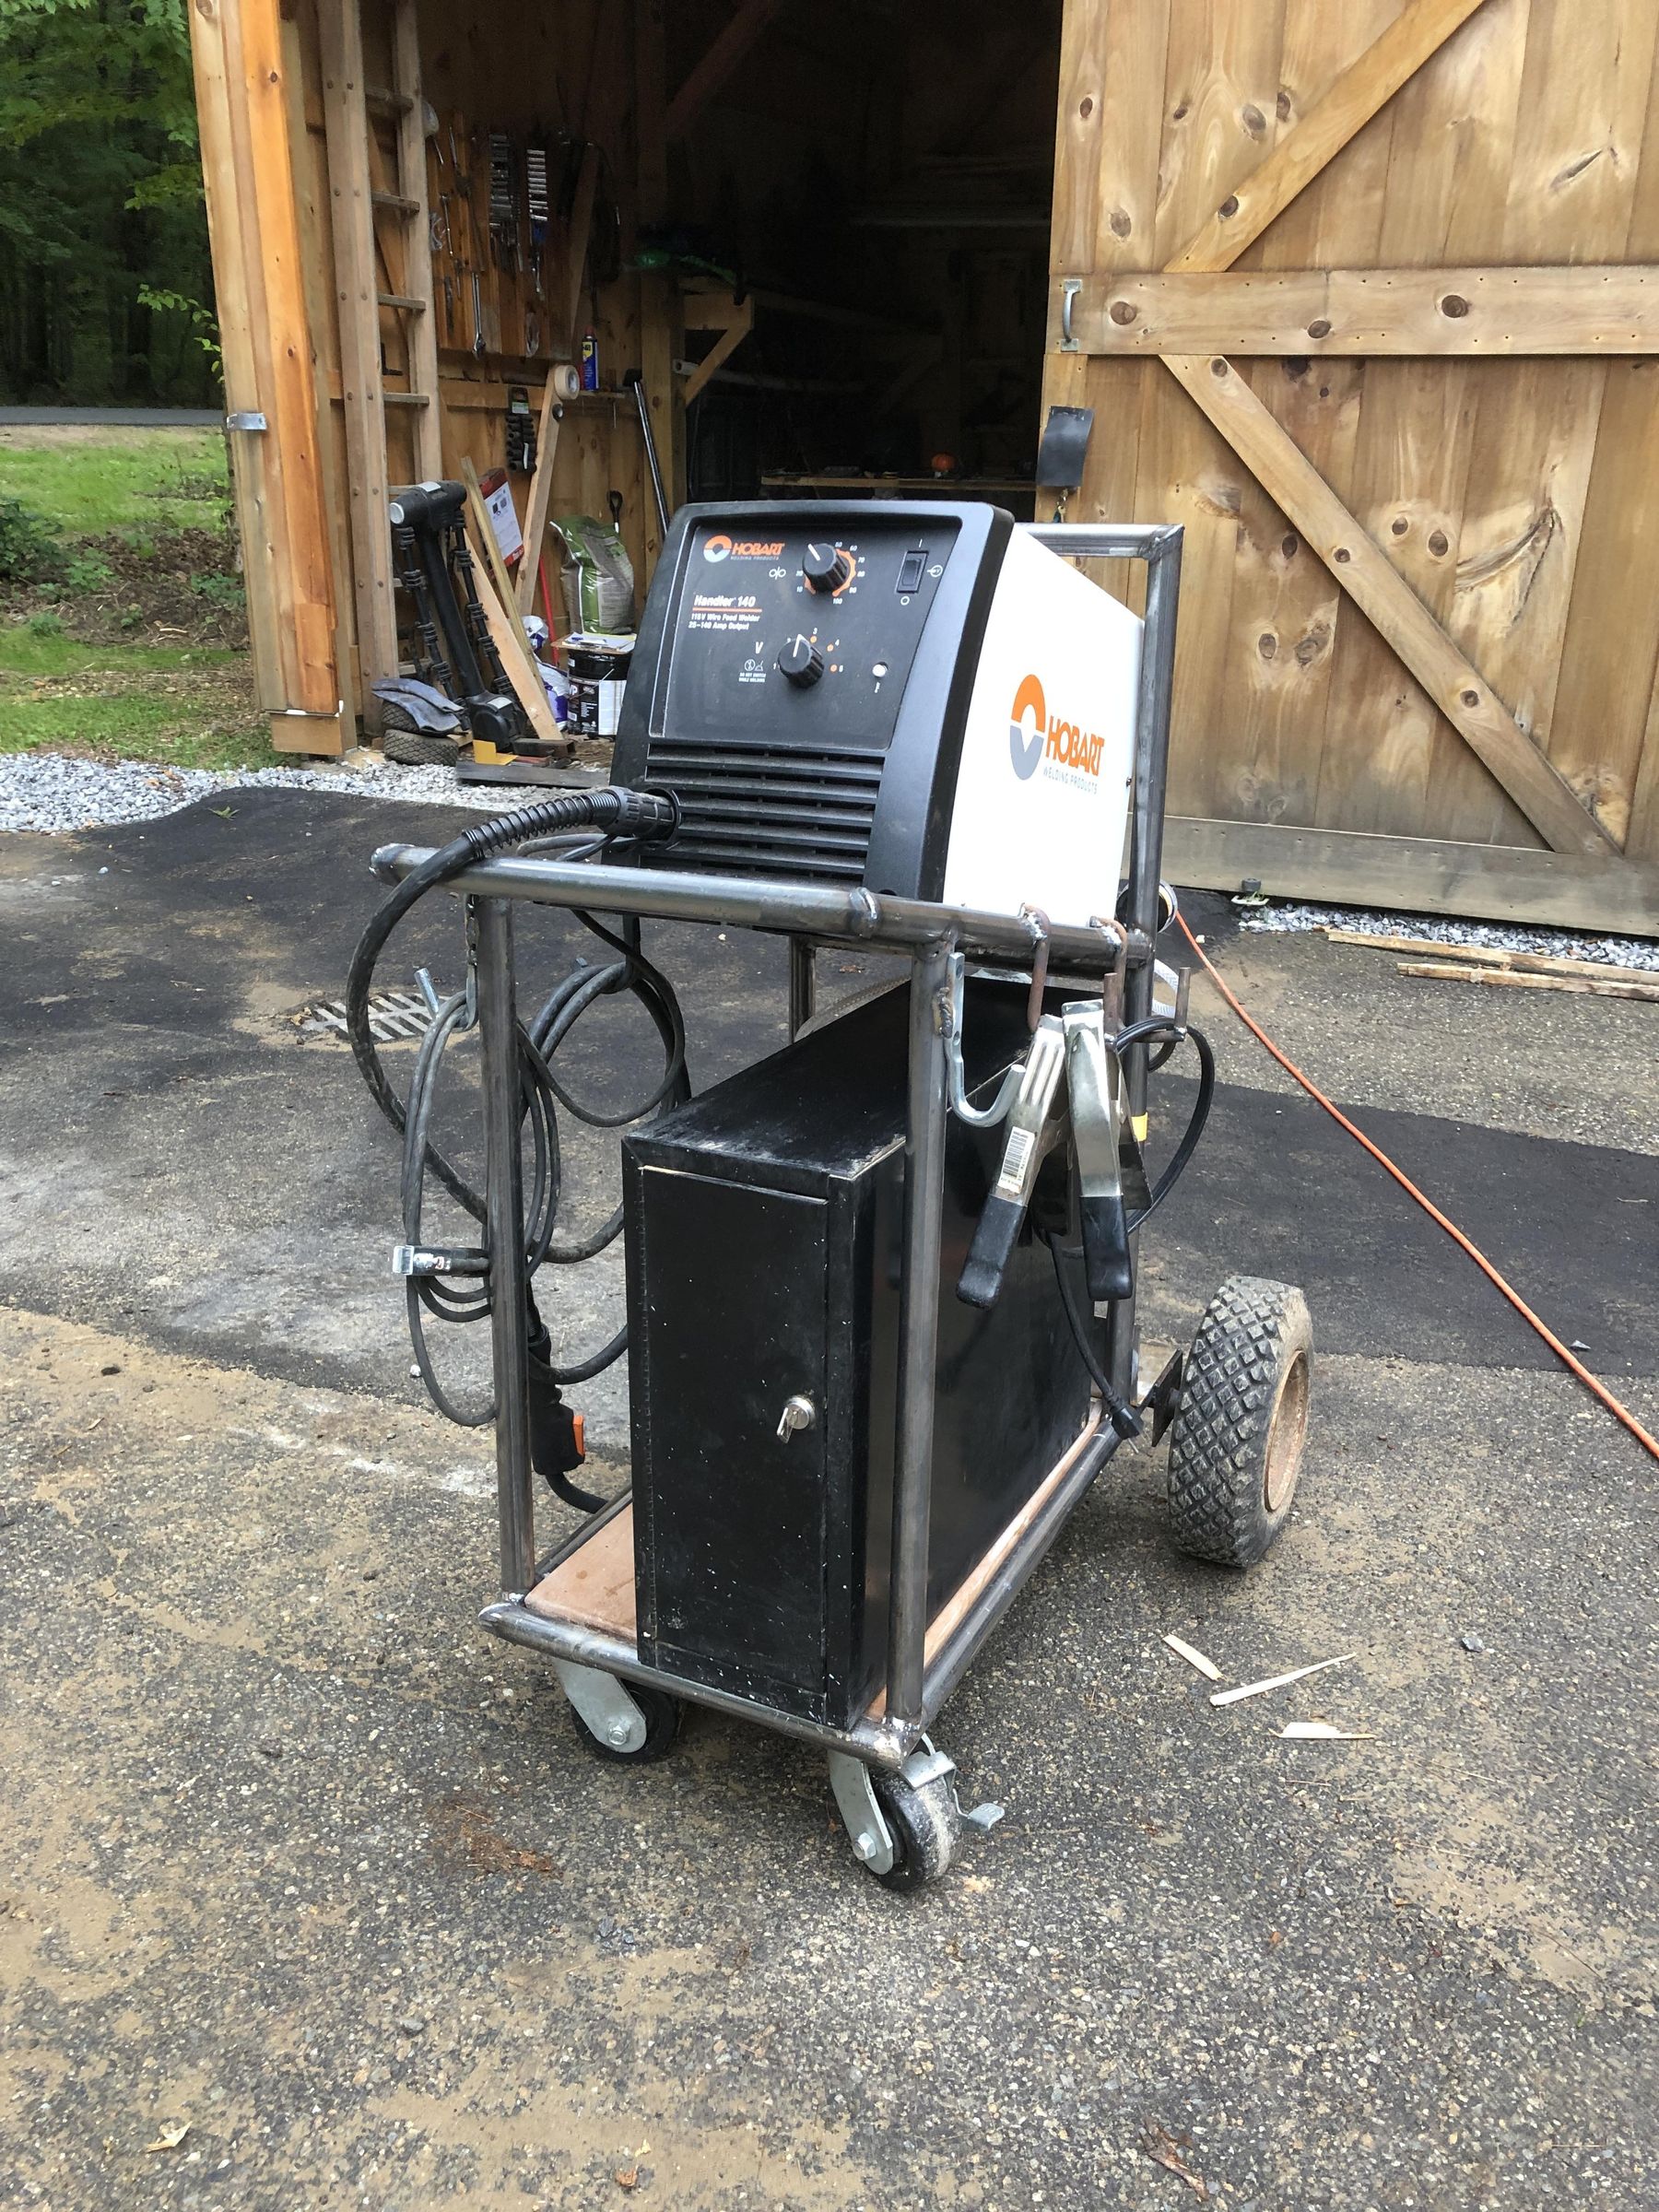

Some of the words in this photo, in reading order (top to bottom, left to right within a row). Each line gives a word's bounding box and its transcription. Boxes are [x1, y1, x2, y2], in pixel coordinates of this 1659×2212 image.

[732, 543, 783, 556] HOBART
[737, 595, 756, 607] 140
[712, 622, 727, 630] Amp
[728, 622, 749, 630] Output
[755, 641, 764, 653] V
[1045, 714, 1105, 777] HOBART
[1043, 767, 1068, 784] WELDING
[1070, 775, 1098, 794] PRODUCTS
